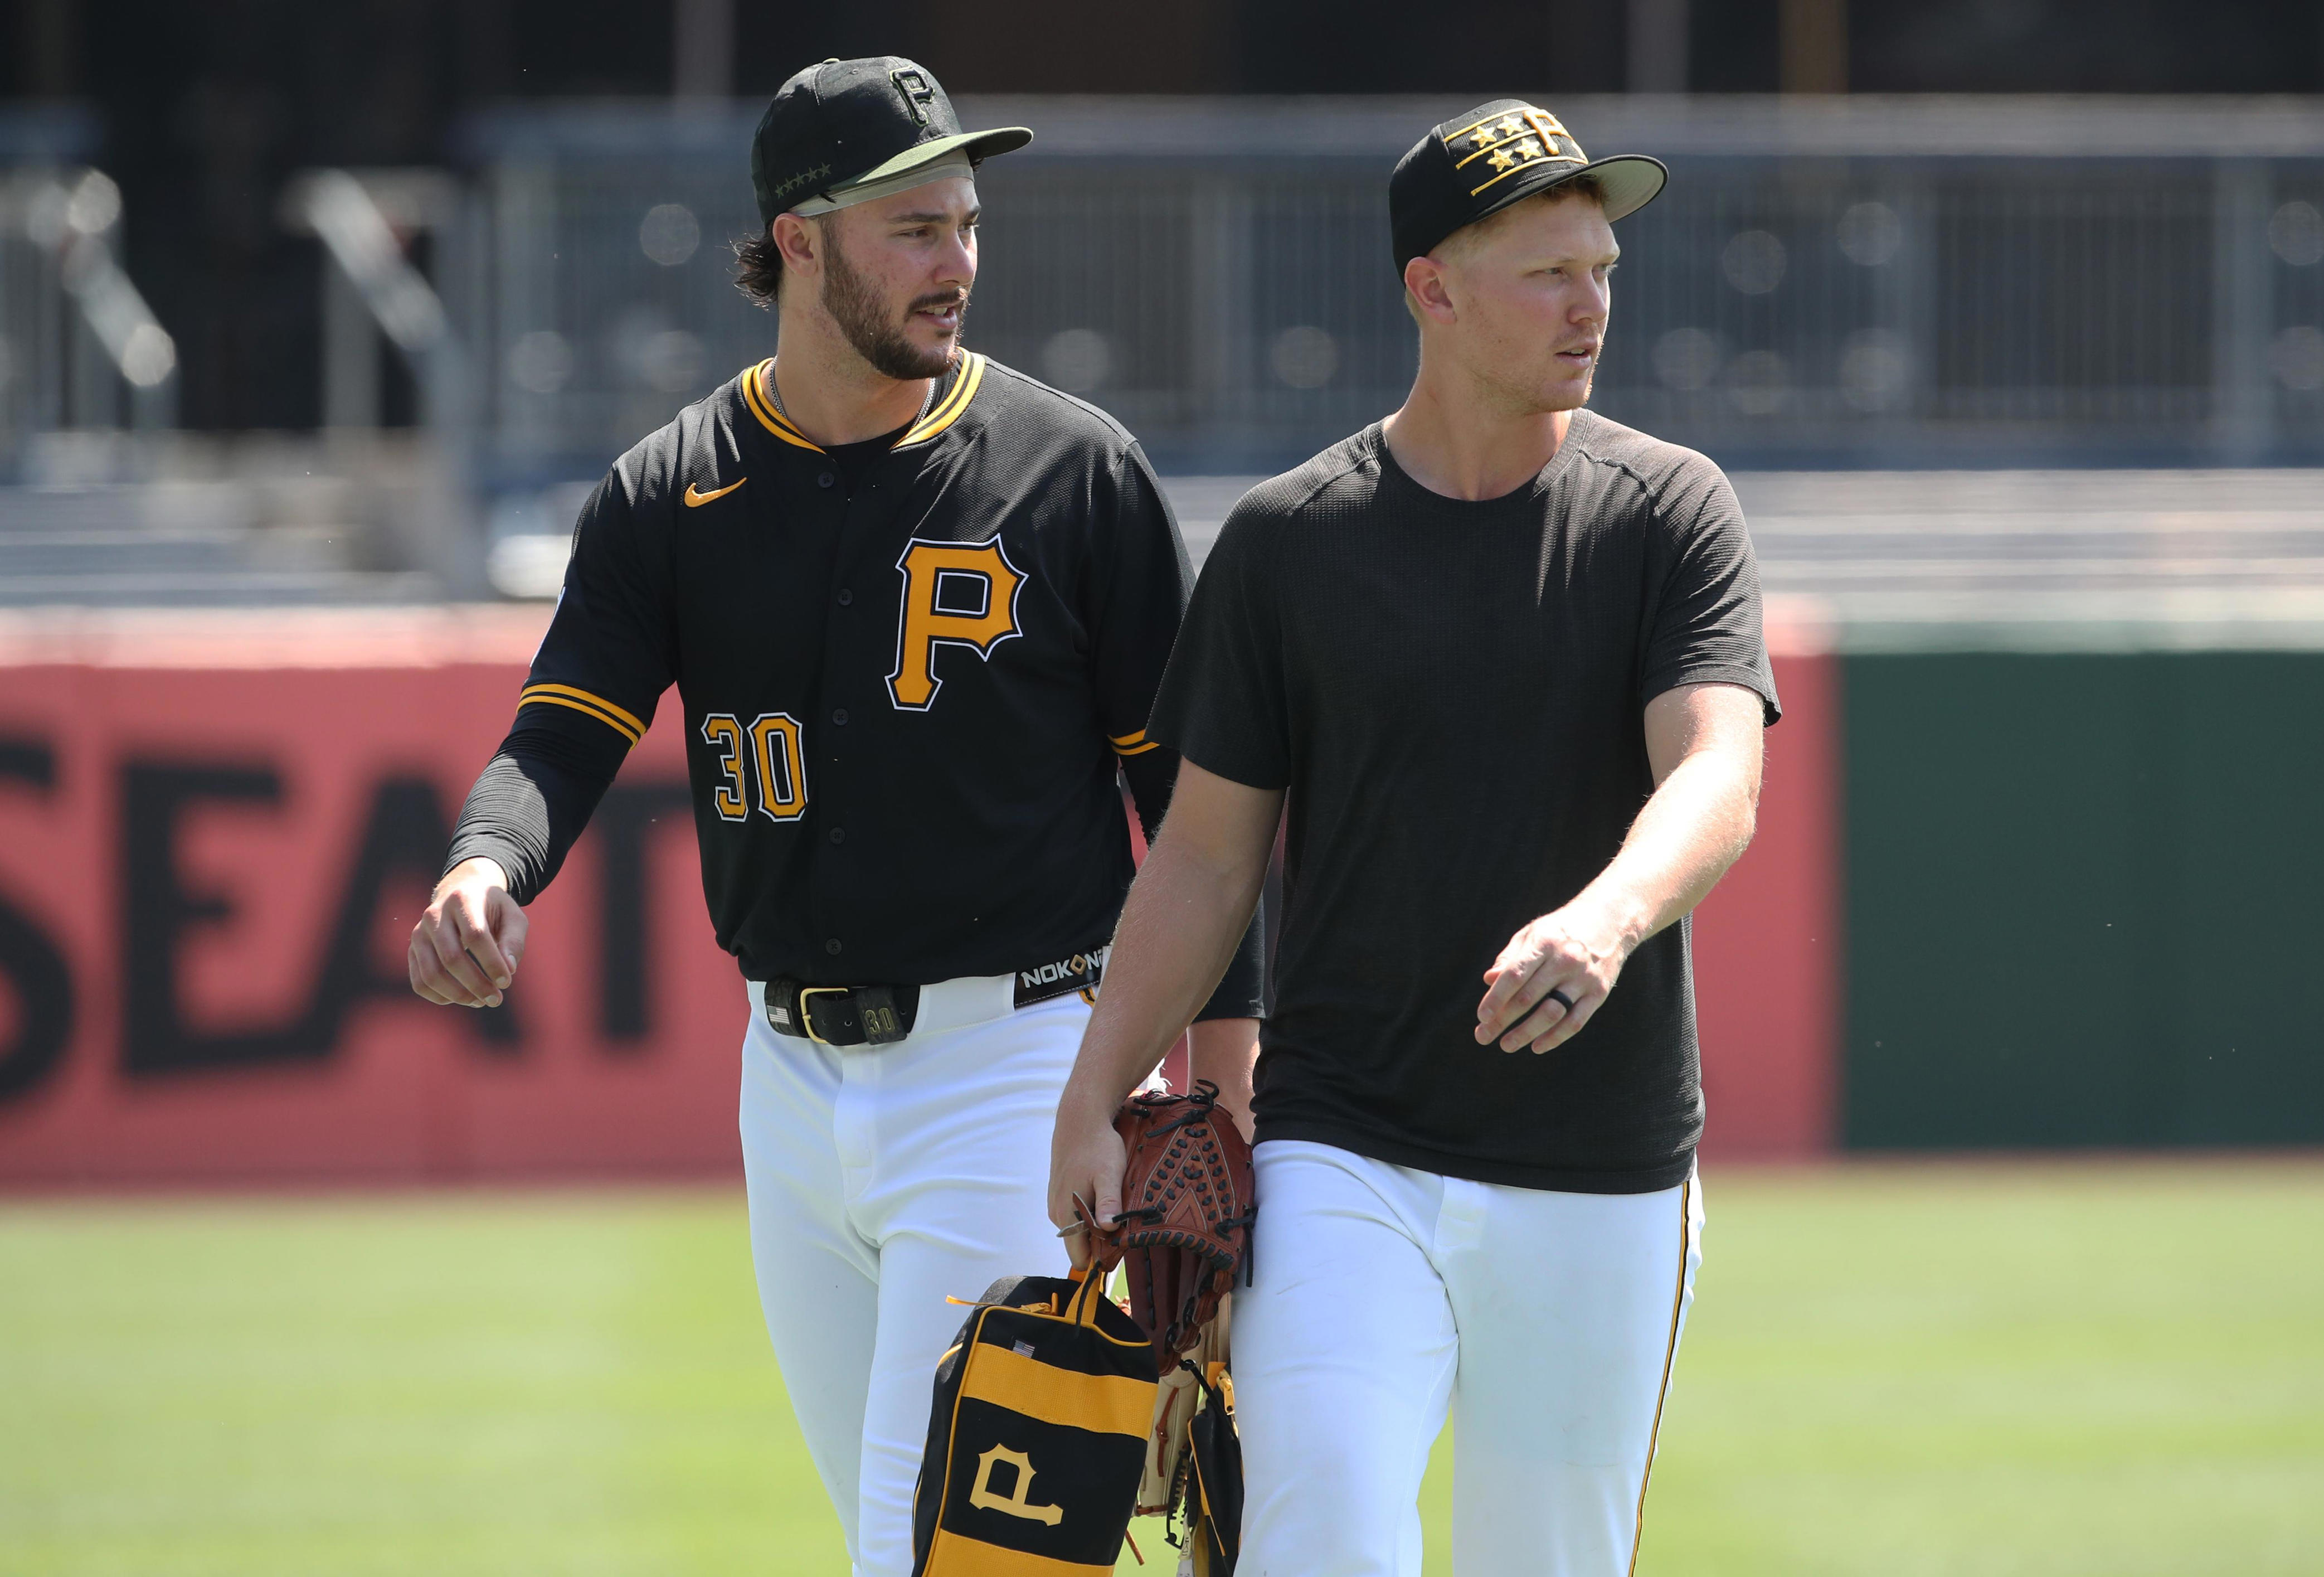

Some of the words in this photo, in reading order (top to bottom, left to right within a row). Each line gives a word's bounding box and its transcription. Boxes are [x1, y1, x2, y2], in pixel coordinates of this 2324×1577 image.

[889, 65, 935, 127] P
[1523, 108, 1572, 156] P
[884, 533, 1029, 712] P
[701, 712, 808, 822] 30
[1021, 949, 1102, 988] NOKON
[865, 1007, 895, 1035] 30
[969, 1443, 1063, 1526] P
